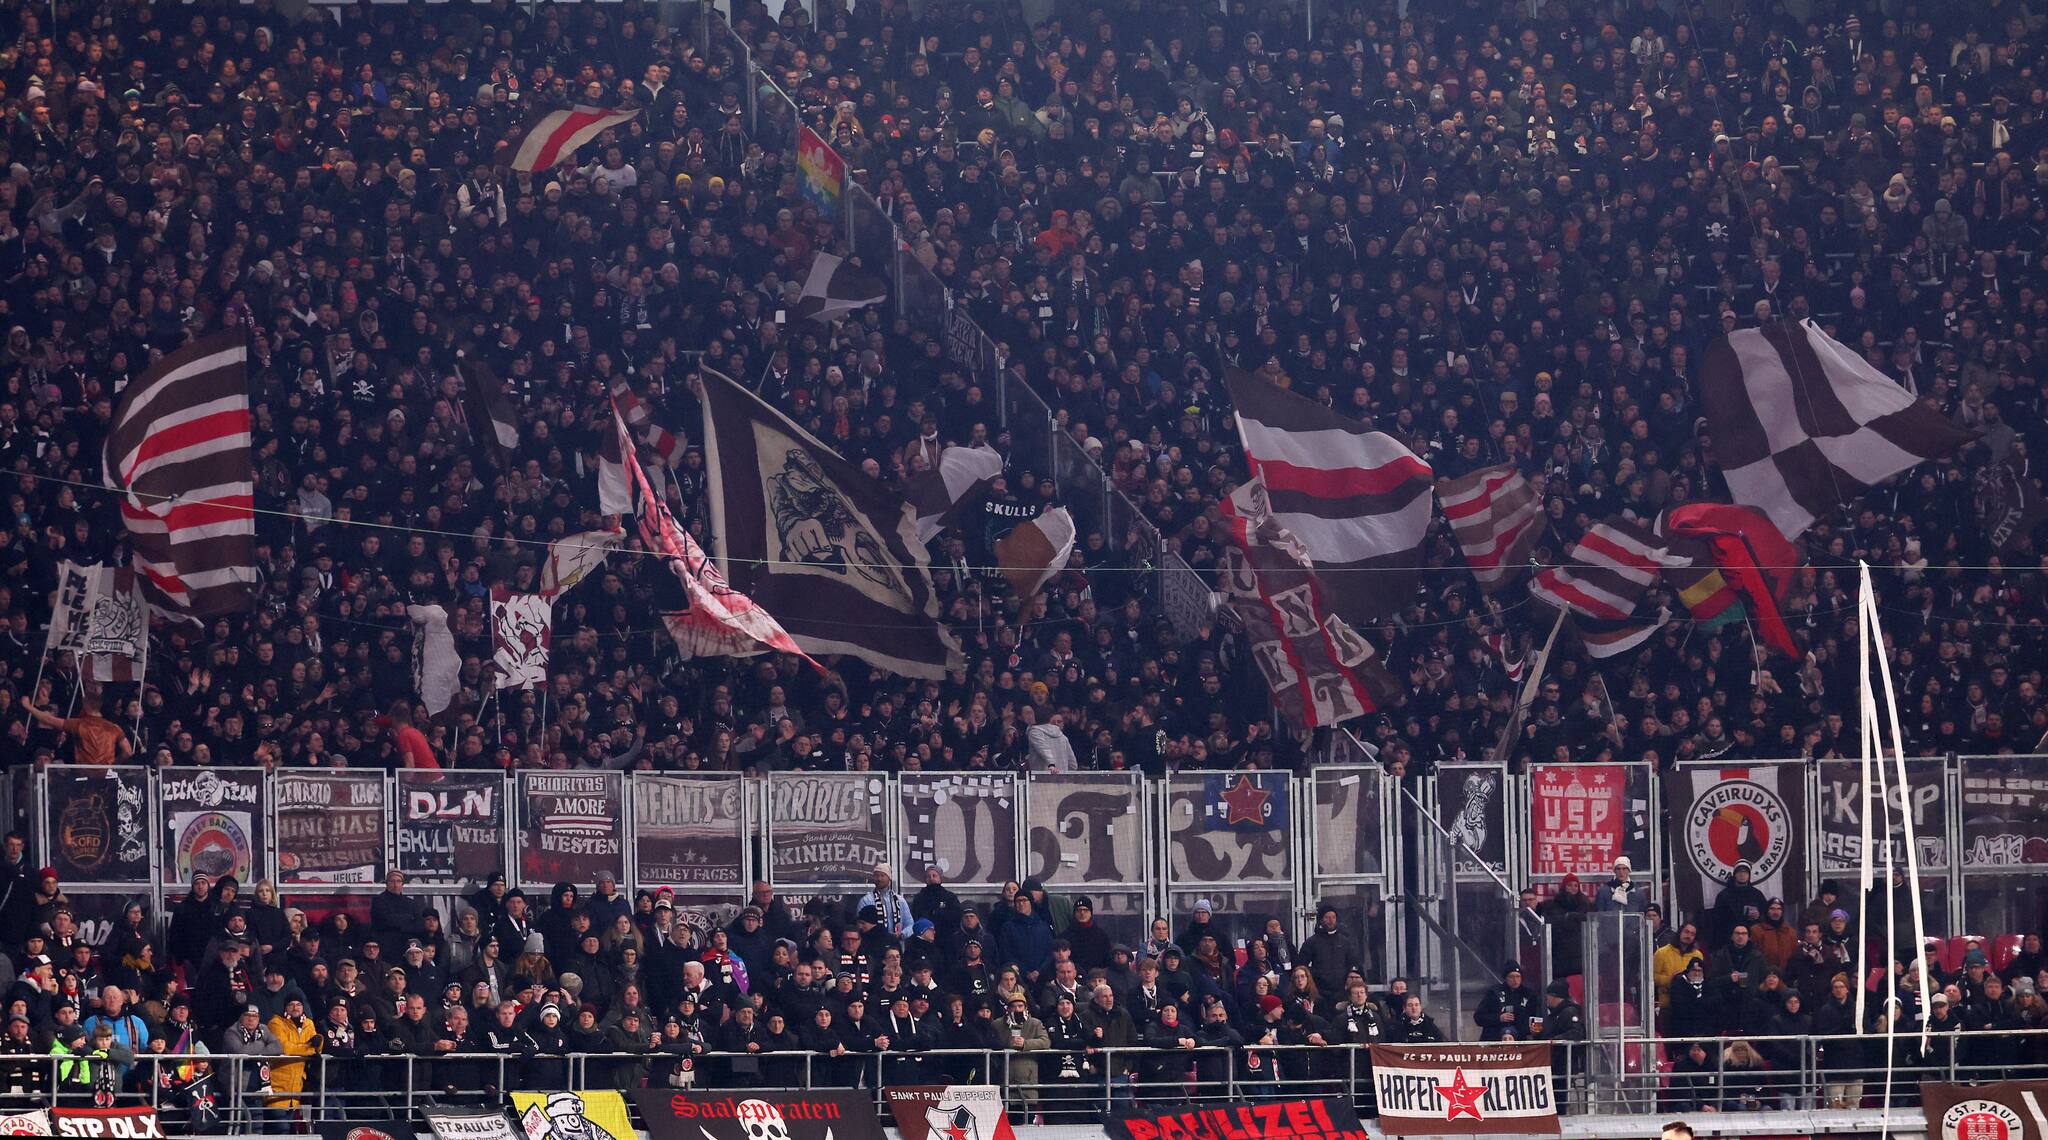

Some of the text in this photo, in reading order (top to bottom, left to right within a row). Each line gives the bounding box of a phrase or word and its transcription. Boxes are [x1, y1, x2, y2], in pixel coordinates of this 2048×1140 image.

[985, 501, 1036, 517] SKULLS
[528, 776, 604, 792] PRIORITAS
[409, 786, 493, 820] DLN
[553, 798, 606, 815] AMORE
[1544, 798, 1609, 831] USP
[1694, 787, 1781, 828] CAVEIRUDXS
[540, 833, 619, 855] WESTEN
[1540, 844, 1612, 862] BEST
[1694, 843, 1706, 858] FC
[1760, 835, 1784, 873] BRASIL
[641, 867, 738, 882] SMILEY FACES
[1403, 1052, 1523, 1063] FC ST. PAULI FANCLUB
[890, 1091, 997, 1101] SANKT PAULI SUPPORT
[1378, 1072, 1549, 1112] HAFEN KLANG
[671, 1094, 841, 1123] Saalepiraten
[1124, 1099, 1336, 1140] PAULIZEI
[1945, 1114, 1958, 1129] FC
[1979, 1102, 2020, 1131] PAULI
[58, 1114, 164, 1139] STP DLX
